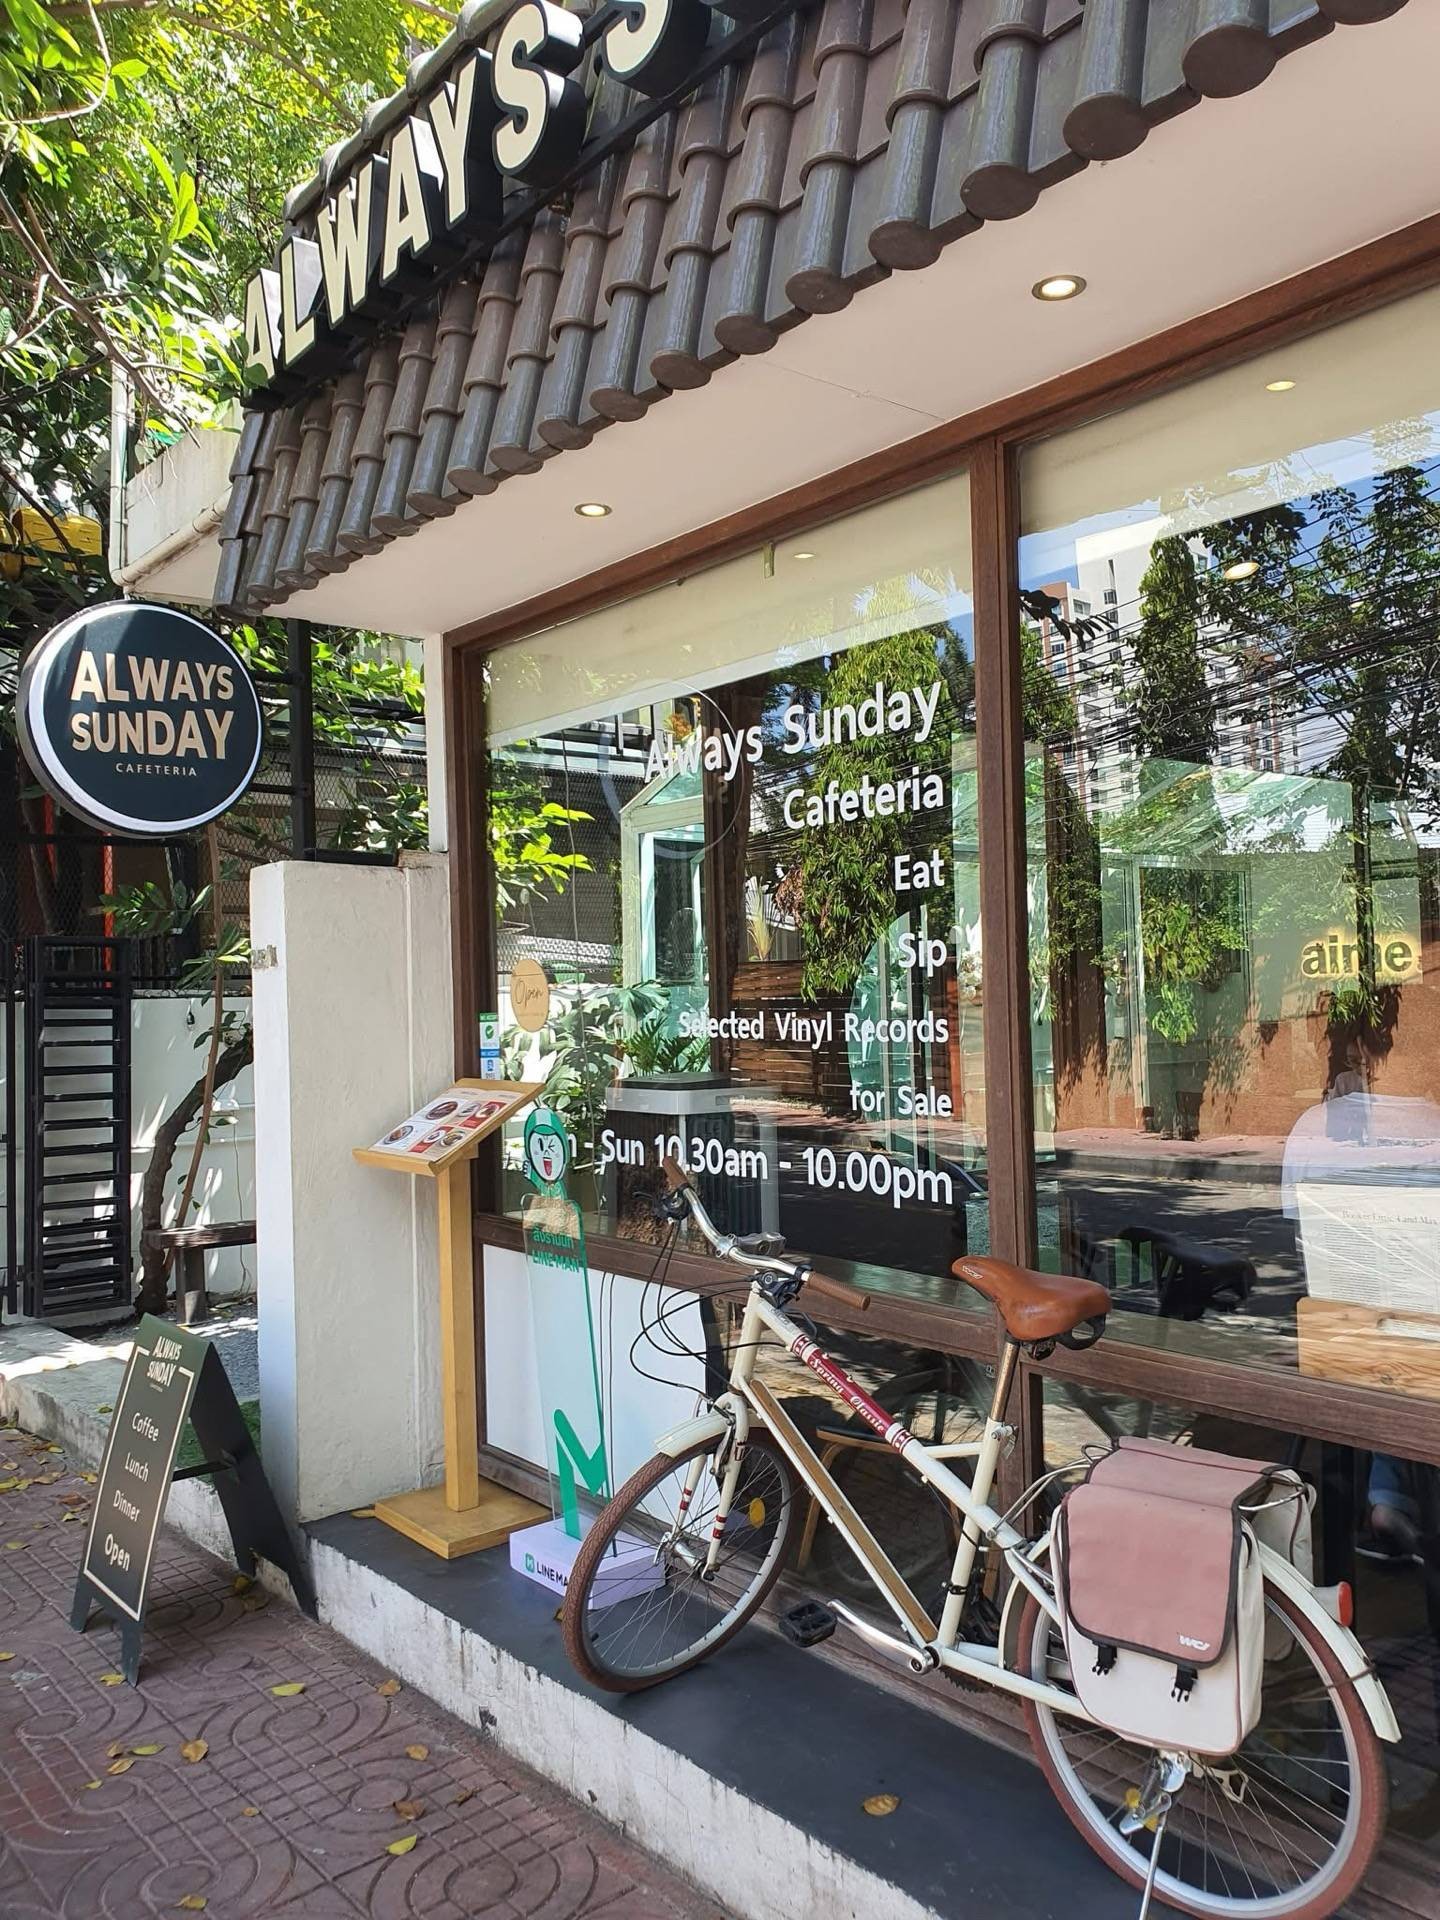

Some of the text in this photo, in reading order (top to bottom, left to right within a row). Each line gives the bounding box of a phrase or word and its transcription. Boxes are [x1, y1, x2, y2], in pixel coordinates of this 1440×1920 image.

[245, 2, 550, 380] ALWAYS
[70, 650, 234, 702] ALWAYS
[71, 708, 234, 760] SUNDAY
[645, 681, 942, 783] Always Sunday
[115, 762, 197, 777] CAFETERIA
[783, 766, 944, 830] Cafeteria
[893, 848, 945, 891] Eat
[899, 931, 948, 977] Sip
[514, 978, 542, 1008] Open
[678, 1011, 950, 1050] Selected Vinyl Records
[849, 1083, 953, 1118] for Sale
[600, 1128, 645, 1168] Sun
[653, 1133, 769, 1180] 10.30am
[802, 1147, 954, 1209] 10.00pm
[152, 1336, 182, 1360] ALWAYS
[147, 1361, 177, 1387] SUNDAY
[132, 1412, 159, 1442] Coffee
[125, 1452, 149, 1482] Lunch
[113, 1490, 140, 1522] Dinner
[105, 1533, 131, 1572] Open
[536, 1563, 570, 1587] LINEMA
